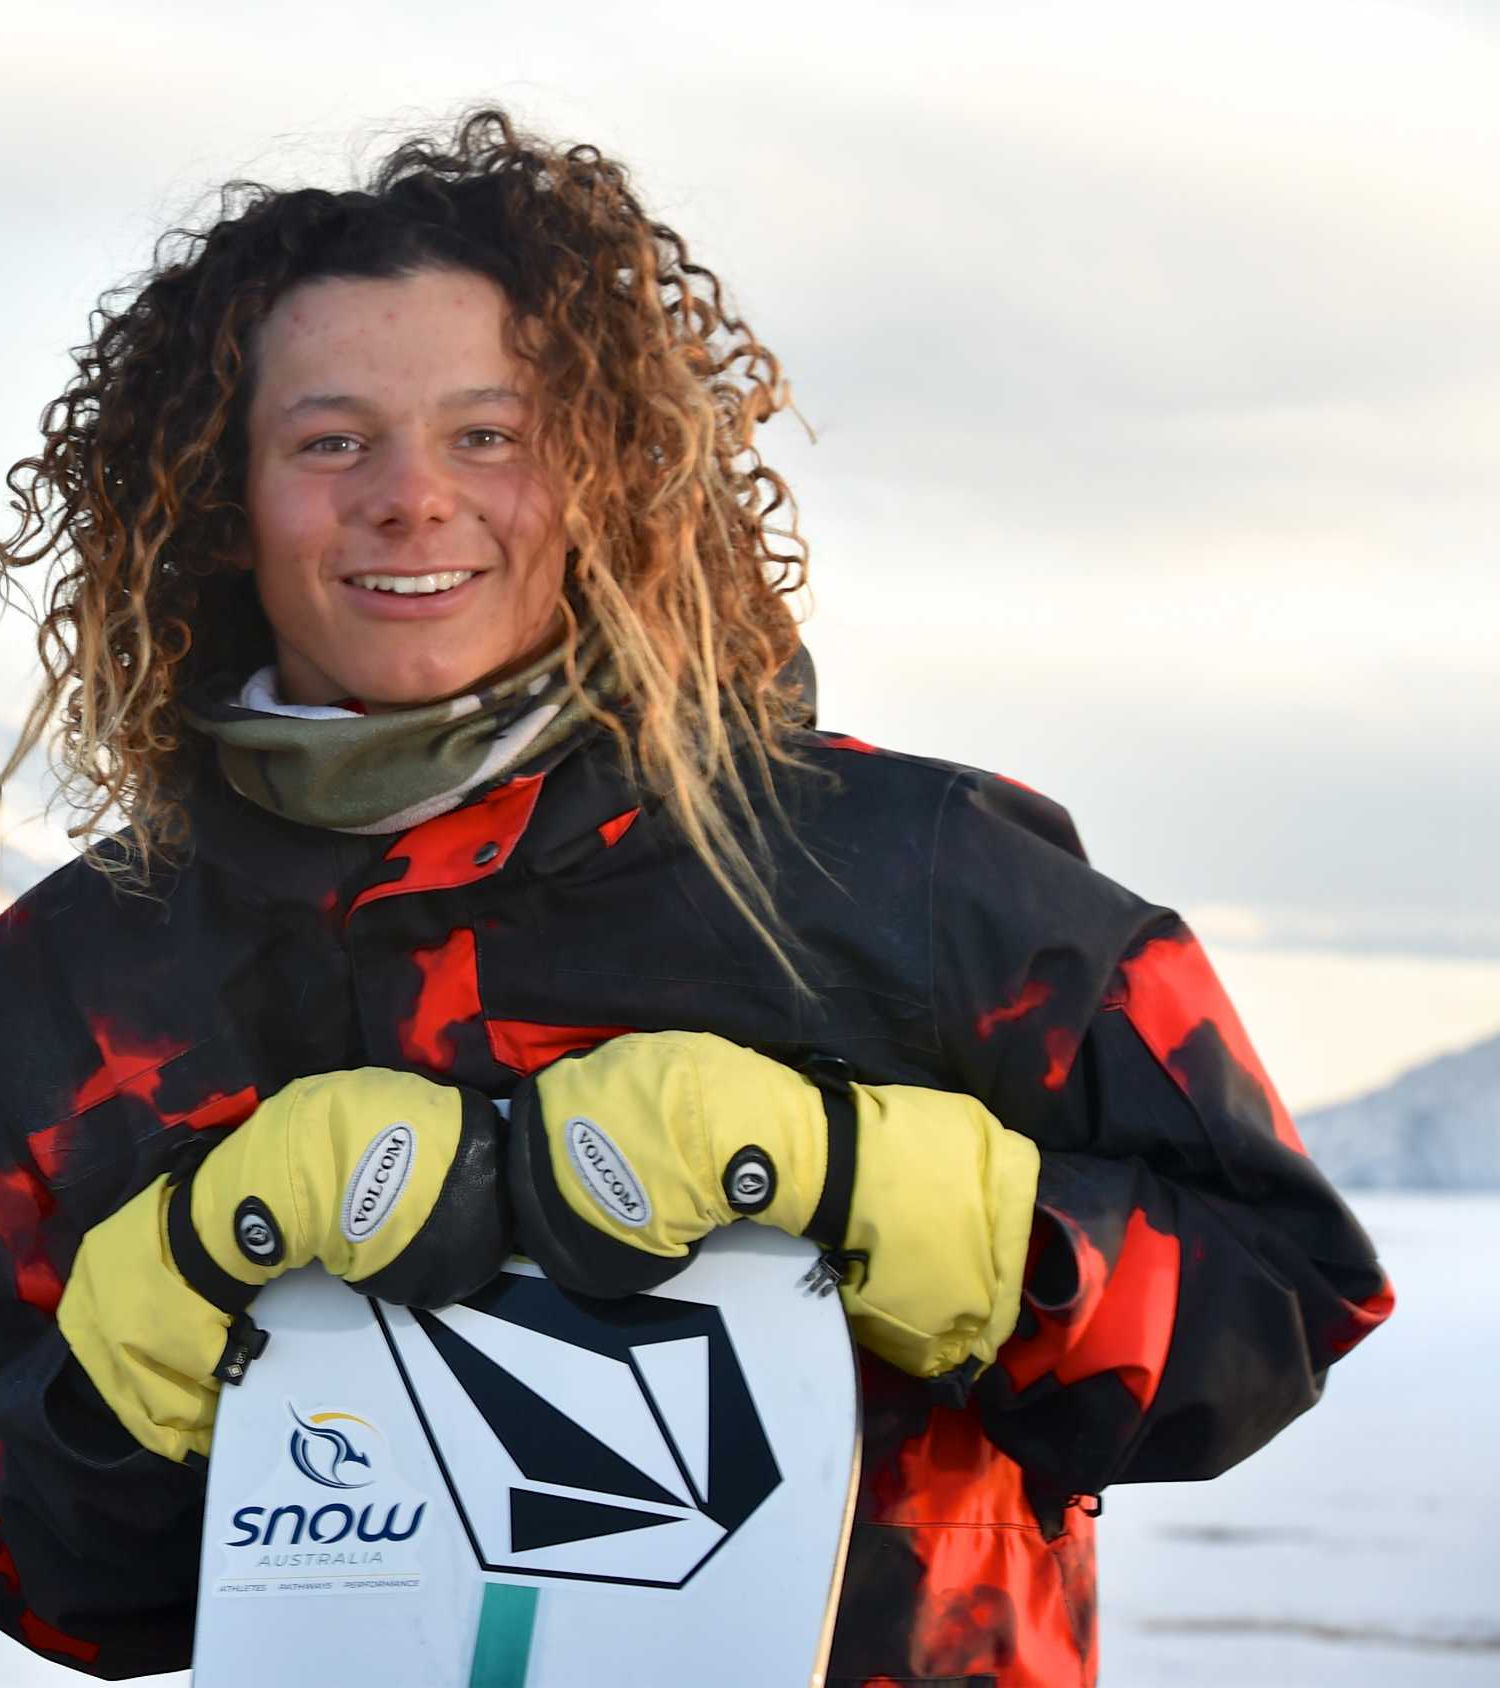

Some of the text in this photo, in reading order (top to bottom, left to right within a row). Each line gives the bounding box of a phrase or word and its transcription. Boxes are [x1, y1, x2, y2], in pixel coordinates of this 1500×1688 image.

[354, 1136, 406, 1224] VOLCOM
[576, 1128, 638, 1215] VOLCOM
[258, 1552, 383, 1567] AUSTRALIA
[220, 1579, 420, 1592] ATHLETES PATHWAYS PERFORMANCE
